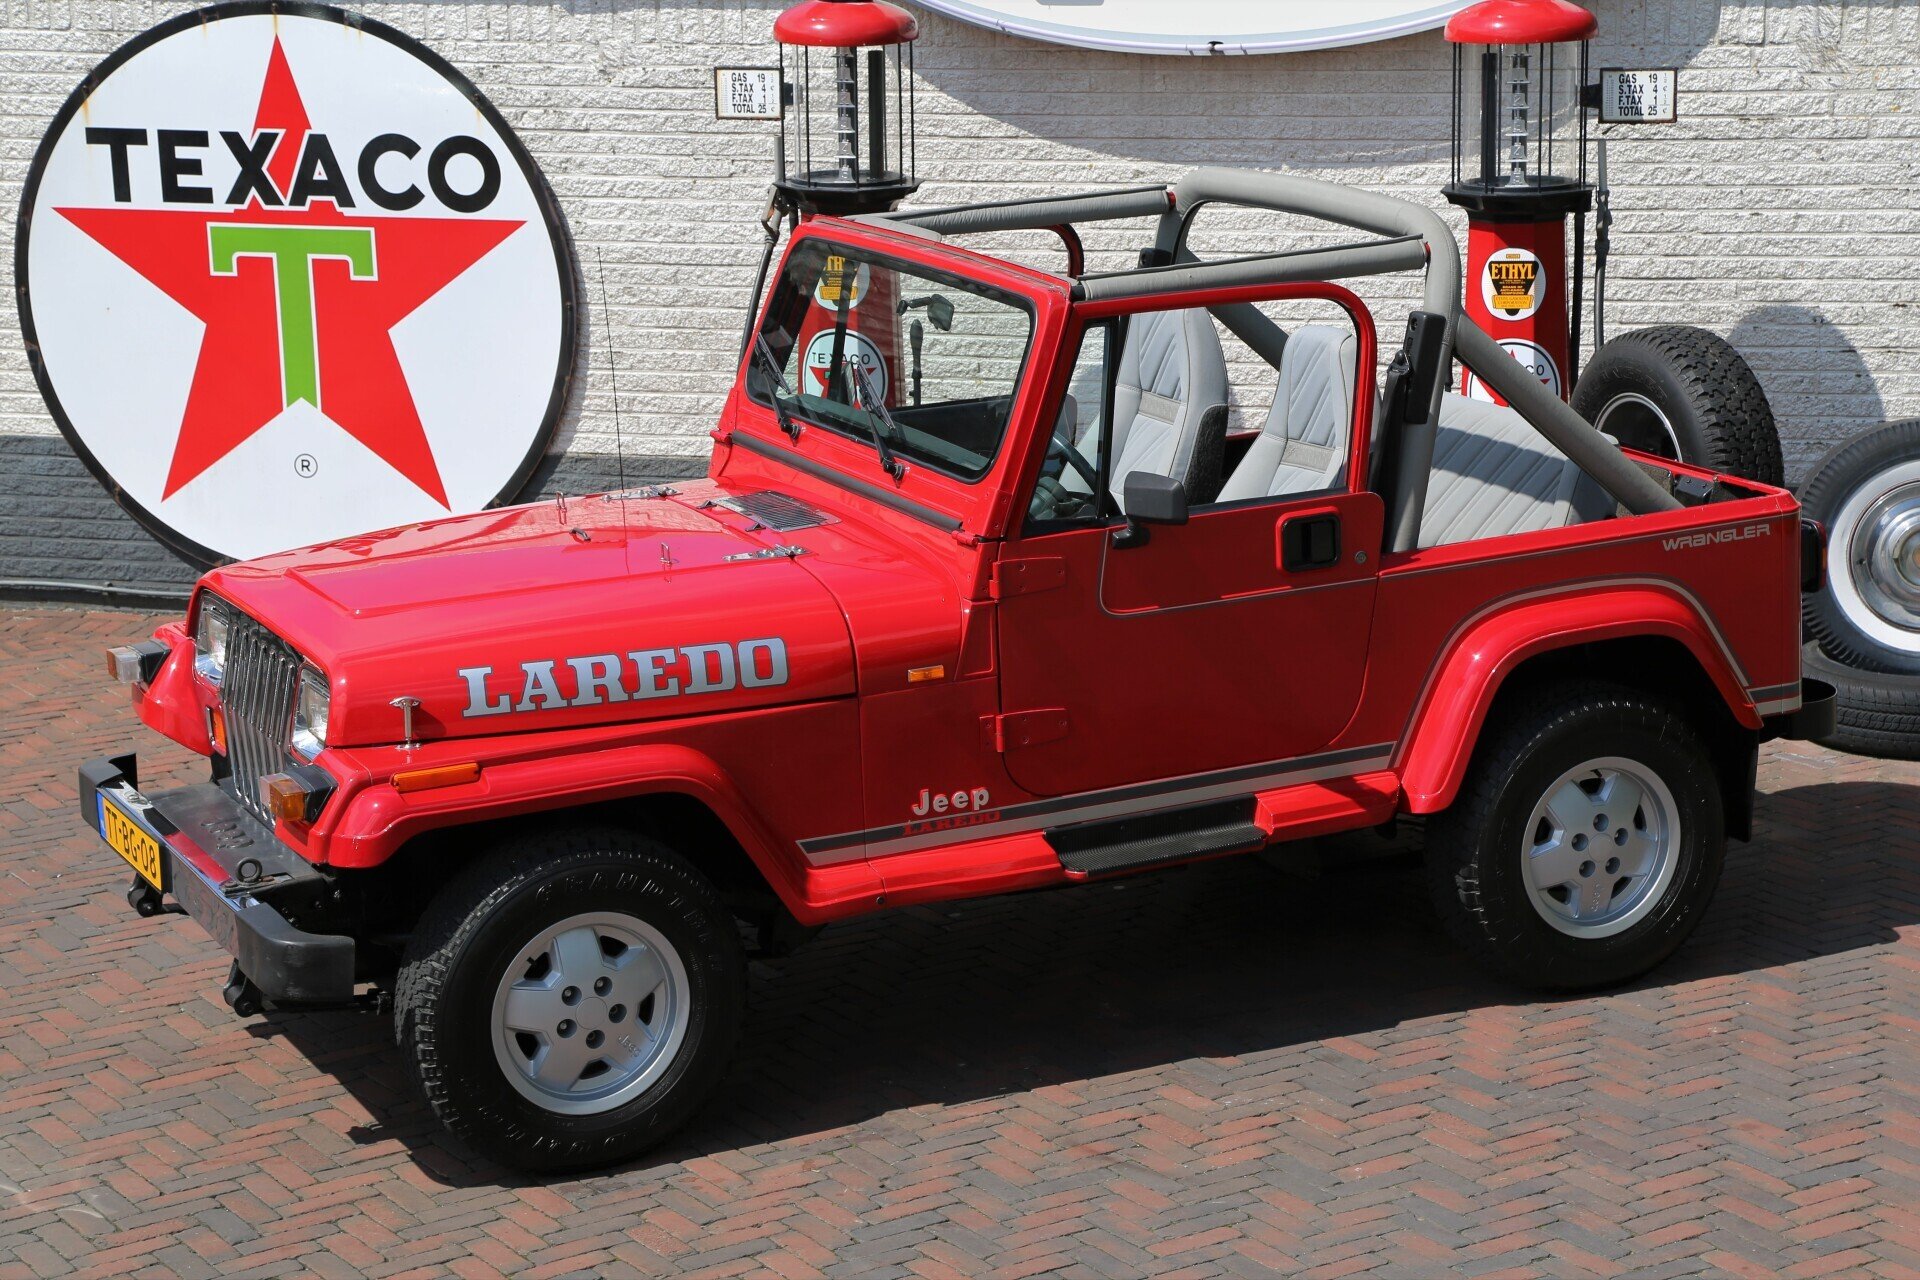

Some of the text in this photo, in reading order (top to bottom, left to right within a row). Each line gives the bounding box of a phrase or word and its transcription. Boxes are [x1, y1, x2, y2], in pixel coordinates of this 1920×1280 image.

[731, 73, 747, 82] GAS
[757, 73, 766, 83] 19
[1618, 74, 1637, 84] GAS
[1648, 74, 1658, 84] 19
[731, 83, 754, 93] S.TAX
[761, 83, 766, 93] 4
[1618, 85, 1644, 94] S.TAX
[1652, 85, 1658, 94] 4
[732, 94, 753, 103] F.TAX
[762, 95, 766, 104] 1
[1618, 95, 1642, 105] F.TAX
[1653, 95, 1657, 105] 1
[732, 104, 755, 113] TOTAL
[758, 104, 766, 114] 25
[1618, 106, 1644, 116] TOTAL
[1648, 106, 1658, 116] 25
[85, 126, 502, 214] TEXACO
[1491, 263, 1535, 280] ETHYL
[812, 352, 870, 365] TECO
[1662, 523, 1771, 552] WRANGLER
[458, 636, 789, 718] LAREDO
[912, 787, 990, 816] Jeep
[904, 810, 1001, 837] LAREDO
[105, 805, 157, 880] TT-BG-08
